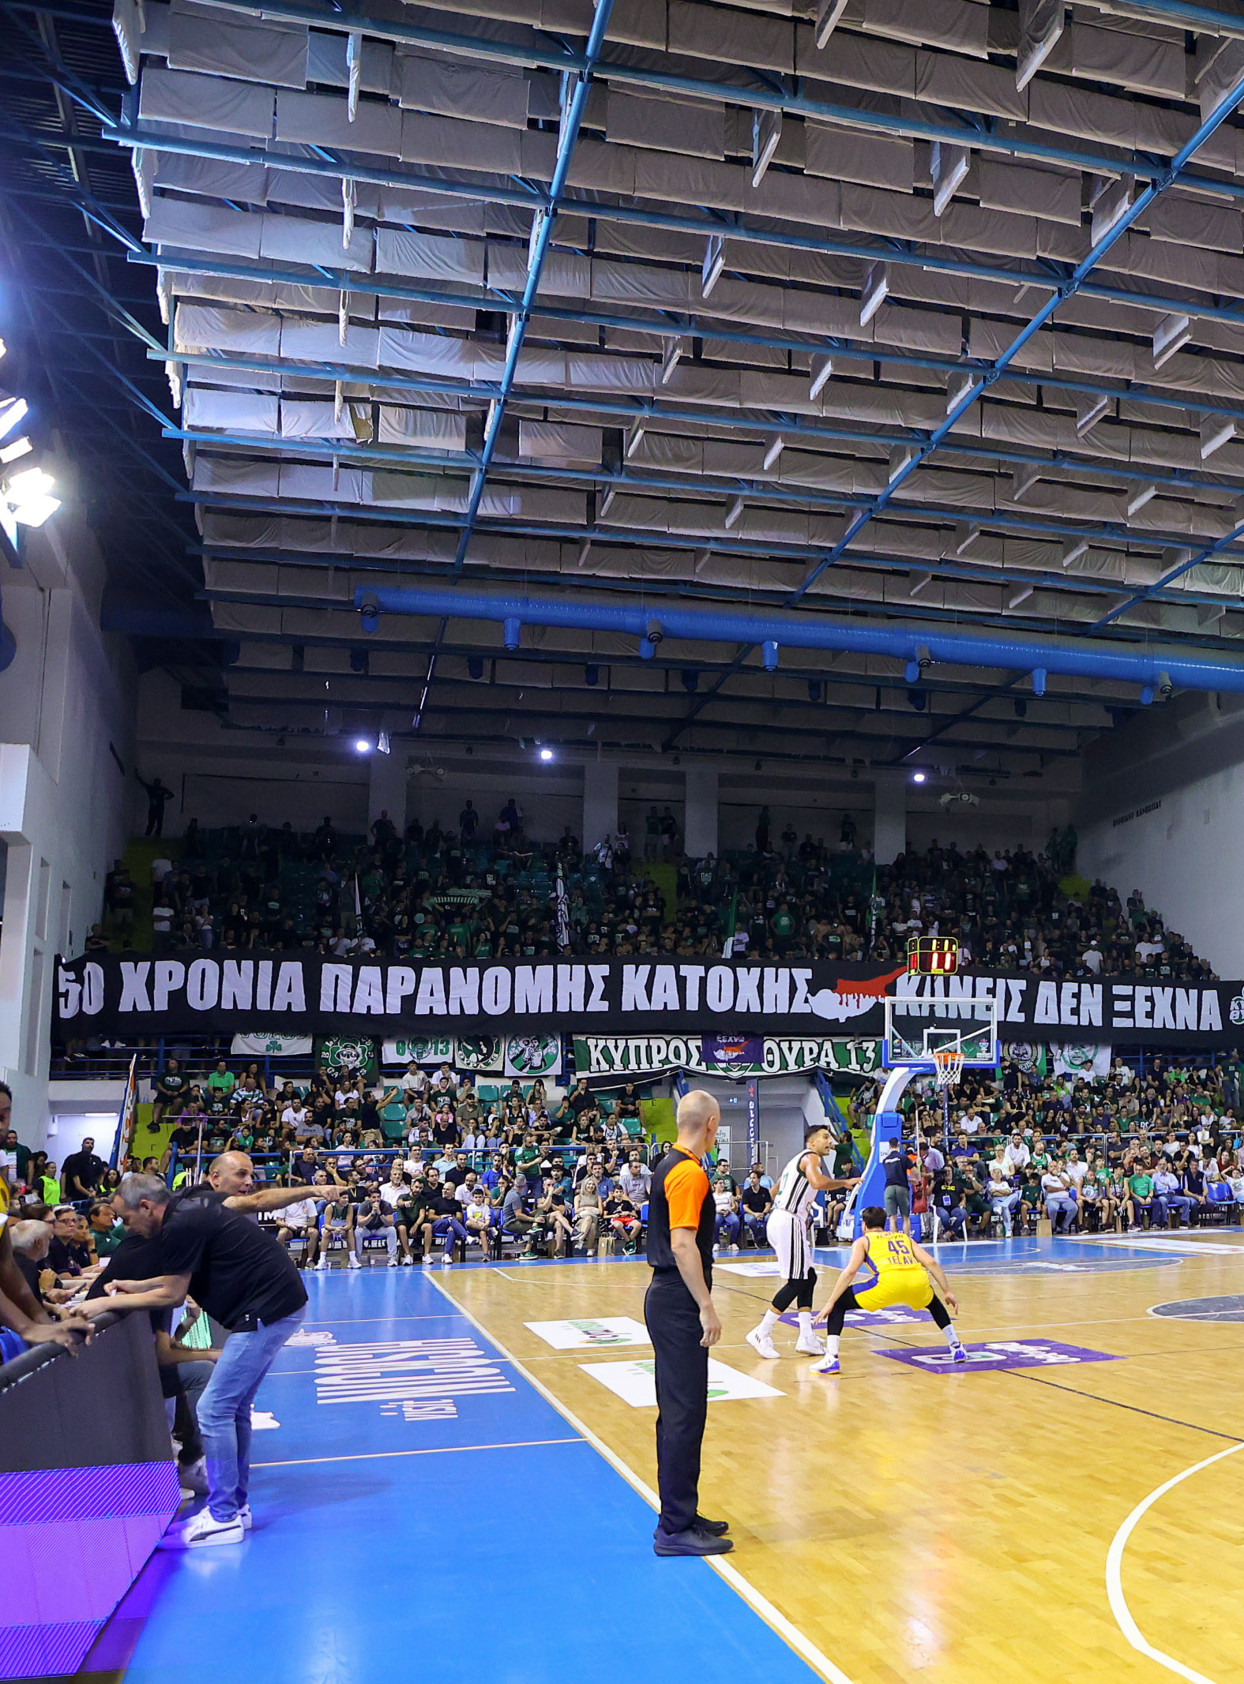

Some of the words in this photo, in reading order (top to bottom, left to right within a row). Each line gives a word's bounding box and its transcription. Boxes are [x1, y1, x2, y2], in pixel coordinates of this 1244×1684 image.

[58, 963, 105, 1019] 50
[118, 959, 306, 1013] ΧΡΟΝΙΑ
[320, 963, 610, 1016] ΠΑΡΑΝΟΜΗΣ
[621, 964, 813, 1015] ΚΑΤΟΧΗΣ
[1034, 980, 1103, 1027] ΔΕΝ
[1111, 985, 1223, 1031] ΞΕΧΝΑ
[586, 1037, 709, 1073] ΚΥΠΡΟΣ
[762, 1038, 839, 1073] ΘΥΡΑ
[846, 1040, 876, 1072] 13
[888, 1240, 910, 1255] 45
